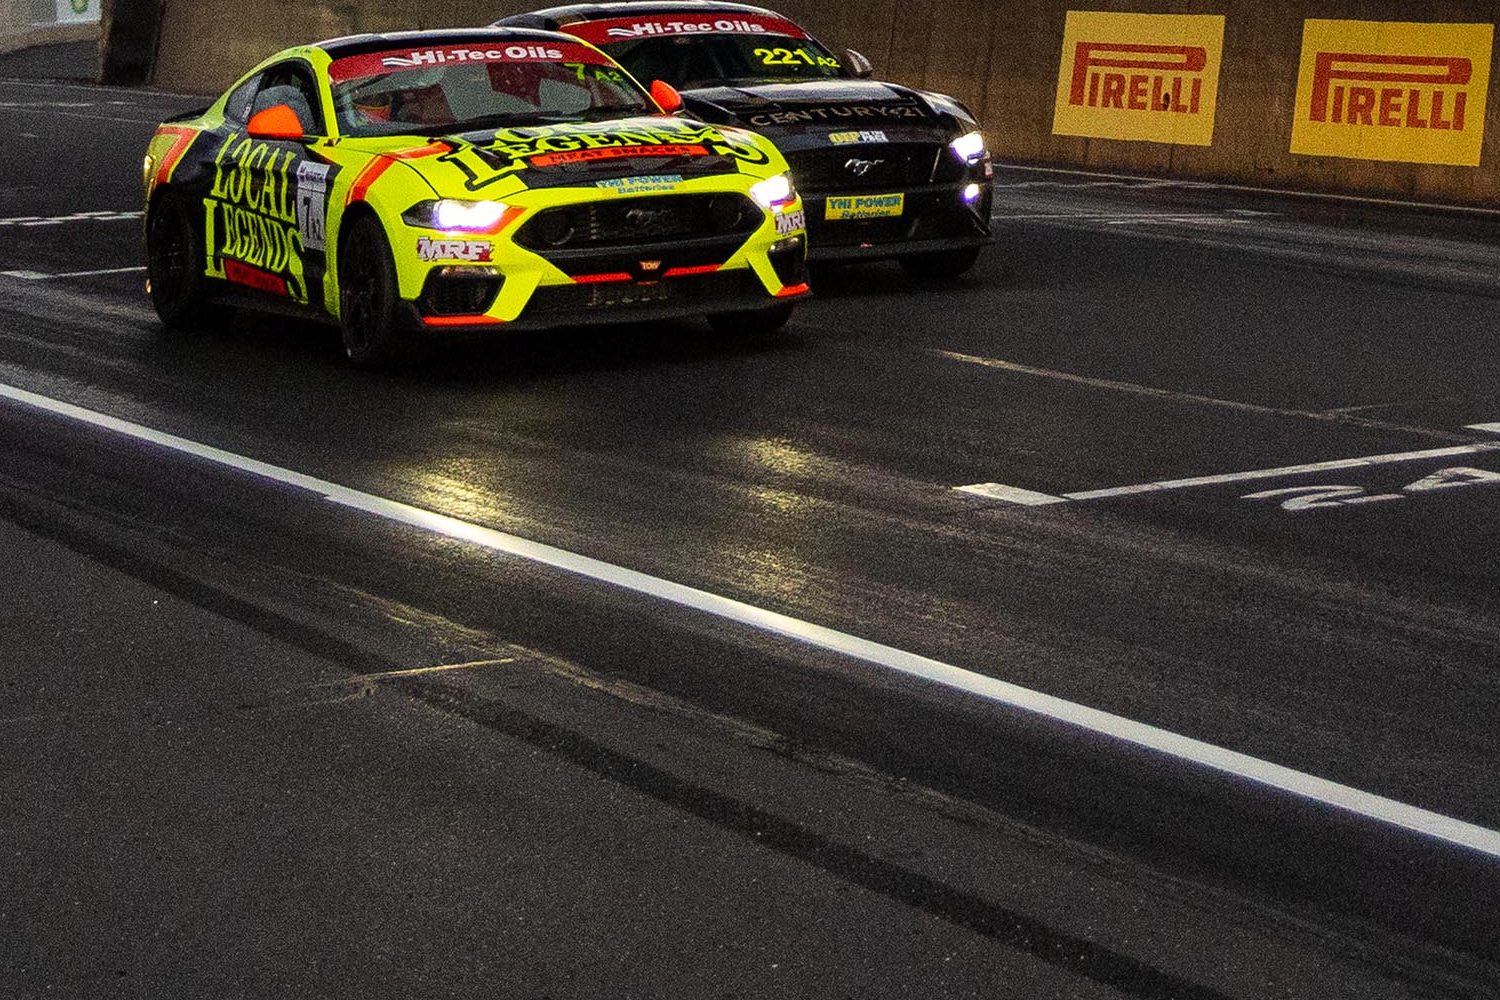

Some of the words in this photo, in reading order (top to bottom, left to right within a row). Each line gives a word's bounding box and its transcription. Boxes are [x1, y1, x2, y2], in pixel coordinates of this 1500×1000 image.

[631, 21, 713, 38] Hi-Tec
[714, 19, 767, 34] Oils
[410, 49, 503, 67] Hi-Tec
[504, 45, 565, 61] Oils
[754, 47, 815, 66] 221
[817, 56, 842, 68] A2
[563, 62, 586, 81] 7
[1069, 41, 1207, 114] PIRELLI
[1310, 52, 1473, 132] PIRELLI
[750, 105, 889, 126] CENTURY
[211, 132, 296, 225] LOCAL
[203, 198, 309, 304] LEGENDS
[417, 236, 491, 261] MRF
